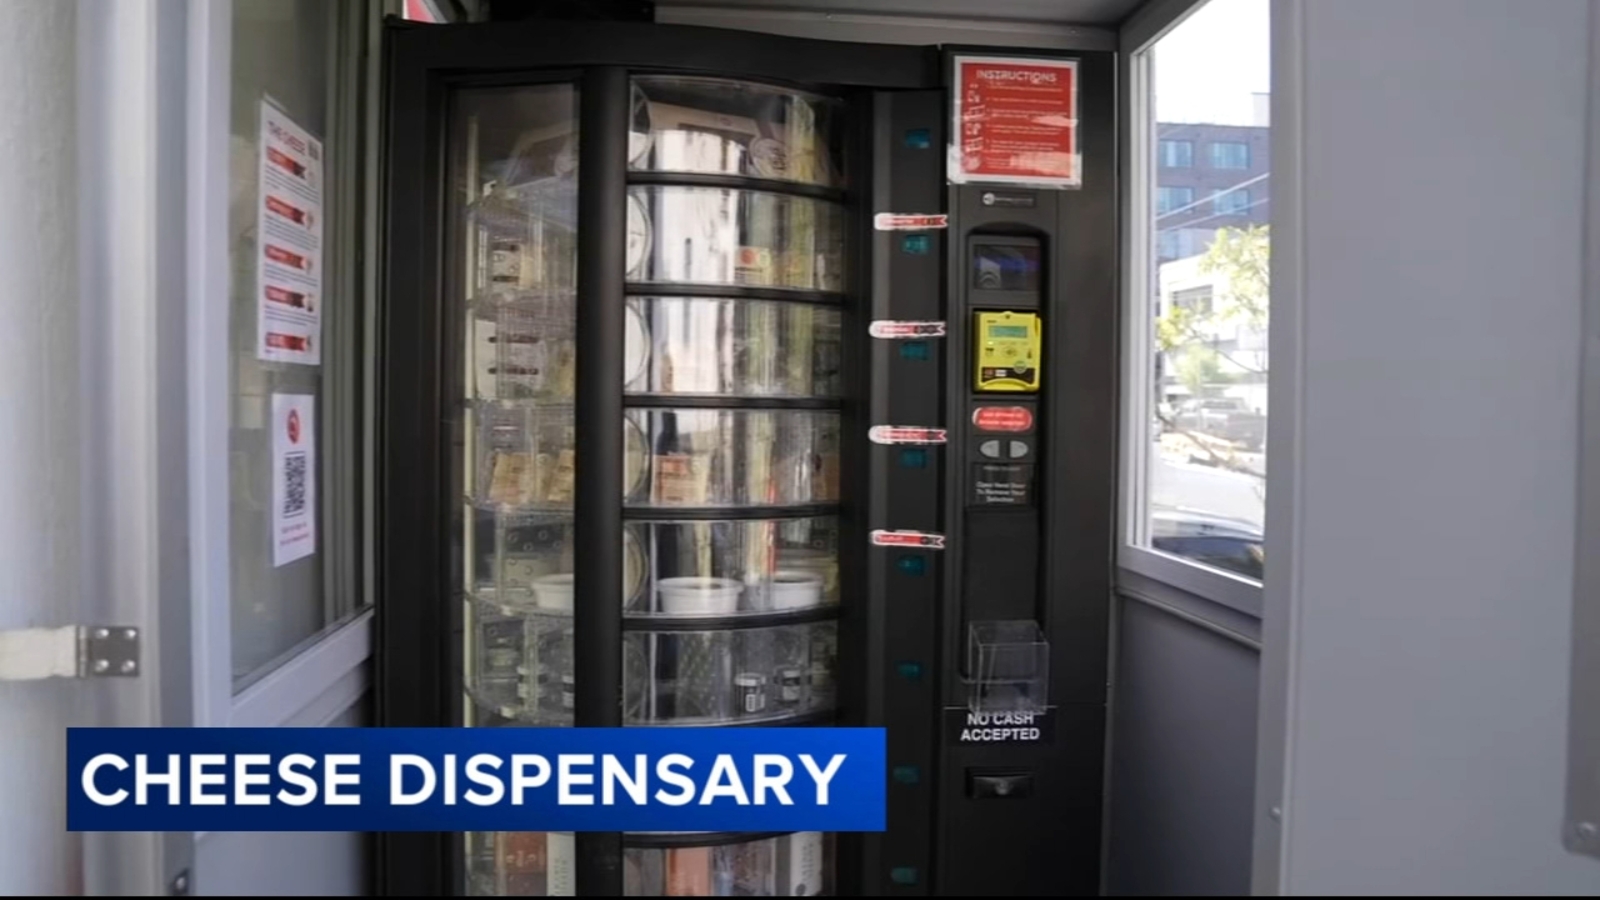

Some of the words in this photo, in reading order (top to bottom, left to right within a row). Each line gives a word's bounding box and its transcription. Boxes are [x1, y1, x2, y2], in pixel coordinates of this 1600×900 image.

[975, 69, 1057, 82] INSTRUCTIONS
[967, 712, 990, 726] NO
[992, 711, 1034, 725] CASH
[960, 727, 1040, 741] ACCEPTED
